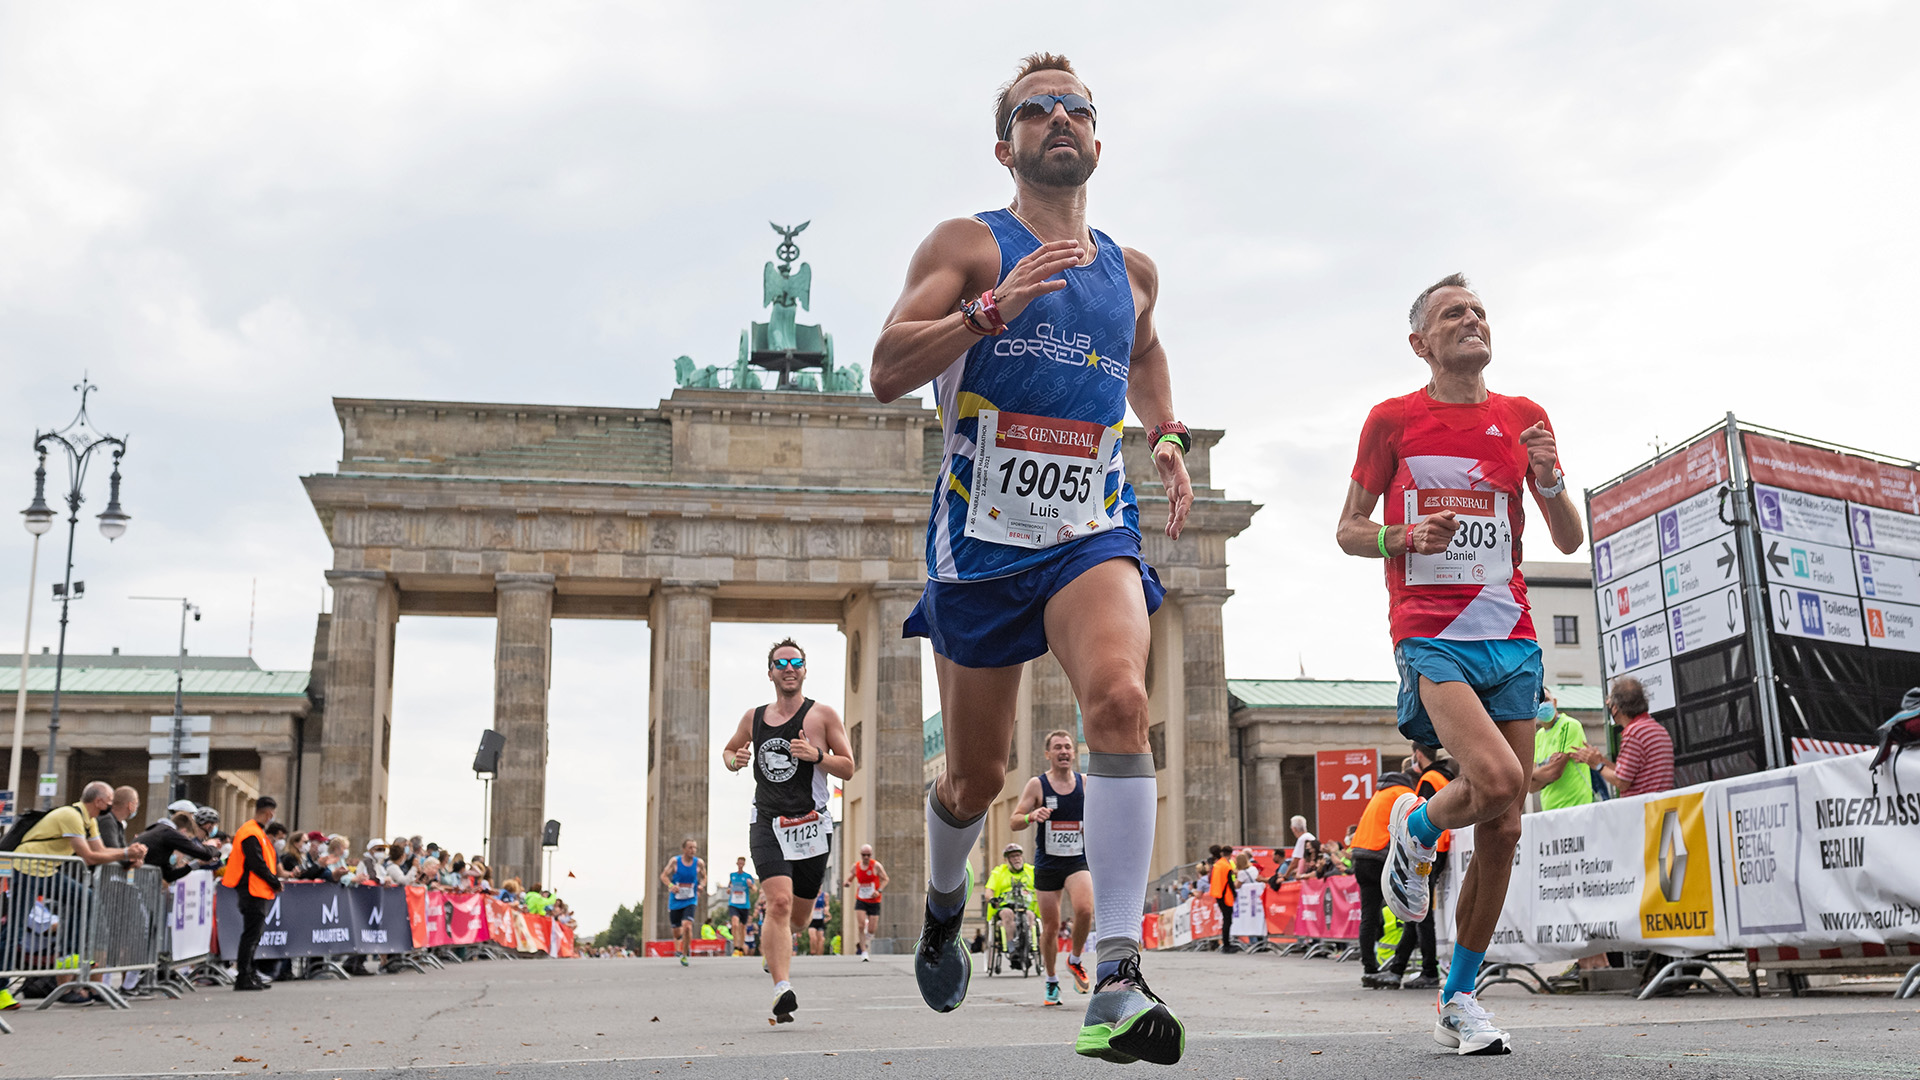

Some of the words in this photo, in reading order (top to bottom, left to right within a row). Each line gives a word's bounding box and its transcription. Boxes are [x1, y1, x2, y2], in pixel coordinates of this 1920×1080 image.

[1036, 323, 1091, 350] CLUB
[1029, 426, 1096, 448] GENERALI
[1485, 429, 1503, 438] adidas
[998, 457, 1094, 504] 19055
[972, 491, 980, 516] GENERALI
[1030, 502, 1060, 519] Luis
[1440, 495, 1489, 510] GENERALI
[1008, 531, 1031, 540] BERLIN
[1446, 520, 1497, 550] 303
[1445, 550, 1476, 561] Daniel
[1810, 552, 1825, 565] Ziel
[1680, 560, 1692, 576] Ziel
[1813, 570, 1835, 584] Finish
[1681, 578, 1700, 593] Finish
[1823, 600, 1860, 618] Toiletten
[1885, 611, 1913, 628] Crossing
[1638, 622, 1667, 639] Toiletten
[1826, 622, 1851, 637] Toilets
[1887, 627, 1905, 639] Point
[1641, 645, 1660, 660] Toilets
[1320, 791, 1336, 801] km
[1342, 773, 1372, 800] 21
[1736, 803, 1789, 834] RENAULT
[784, 823, 819, 843] 11123
[1539, 842, 1544, 856] 4
[1560, 835, 1585, 855] BERLIN
[1737, 832, 1775, 860] RETAIL
[1820, 836, 1865, 870] BERLIN
[1581, 857, 1613, 875] Pankow
[1739, 858, 1777, 886] GROUP
[1582, 875, 1636, 898] Reinickendorf
[1645, 910, 1708, 932] RENAULT
[311, 928, 350, 944] MAURTEN
[1536, 924, 1553, 944] WIR
[1555, 923, 1579, 943] SIND
